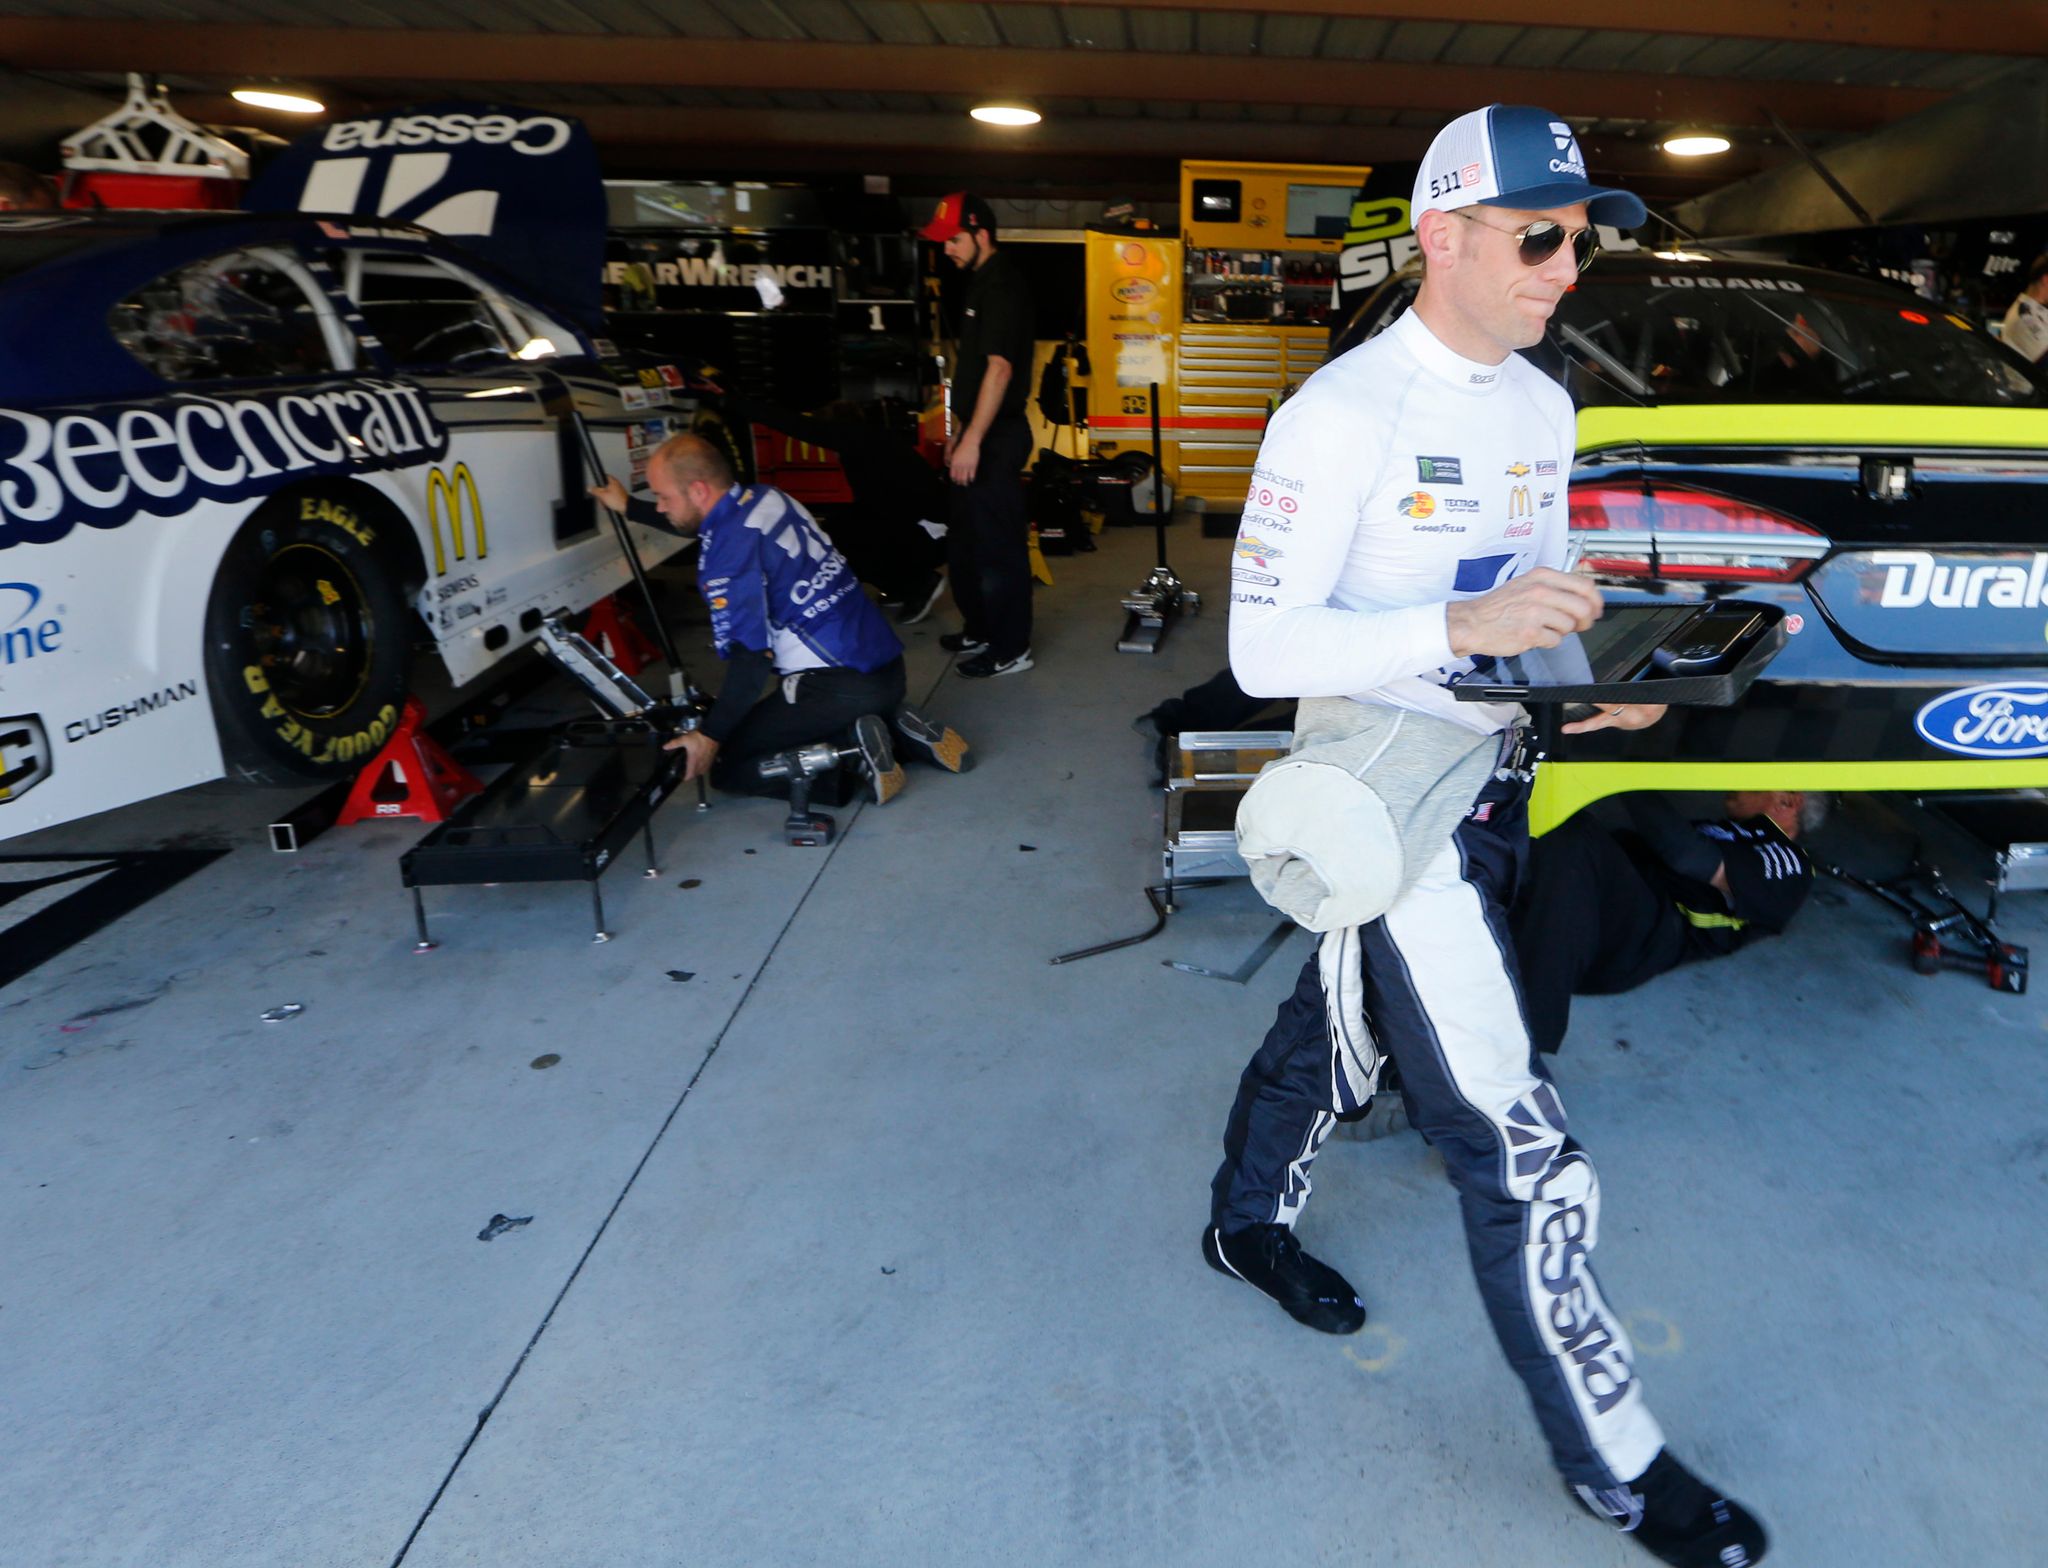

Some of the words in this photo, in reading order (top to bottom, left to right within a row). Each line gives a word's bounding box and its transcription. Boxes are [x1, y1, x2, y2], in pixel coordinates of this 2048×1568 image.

[322, 113, 571, 156] Cessna
[1430, 171, 1462, 199] 5.11
[602, 257, 832, 288] EARWRENCH
[1651, 275, 1804, 293] LOGANO
[868, 306, 885, 331] 1
[302, 497, 376, 547] EAGLE
[1872, 551, 2048, 608] Dural
[0, 618, 63, 666] ne
[65, 679, 197, 744] CUSHMAN
[244, 665, 398, 764] GOODYEAR
[375, 803, 401, 815] RR
